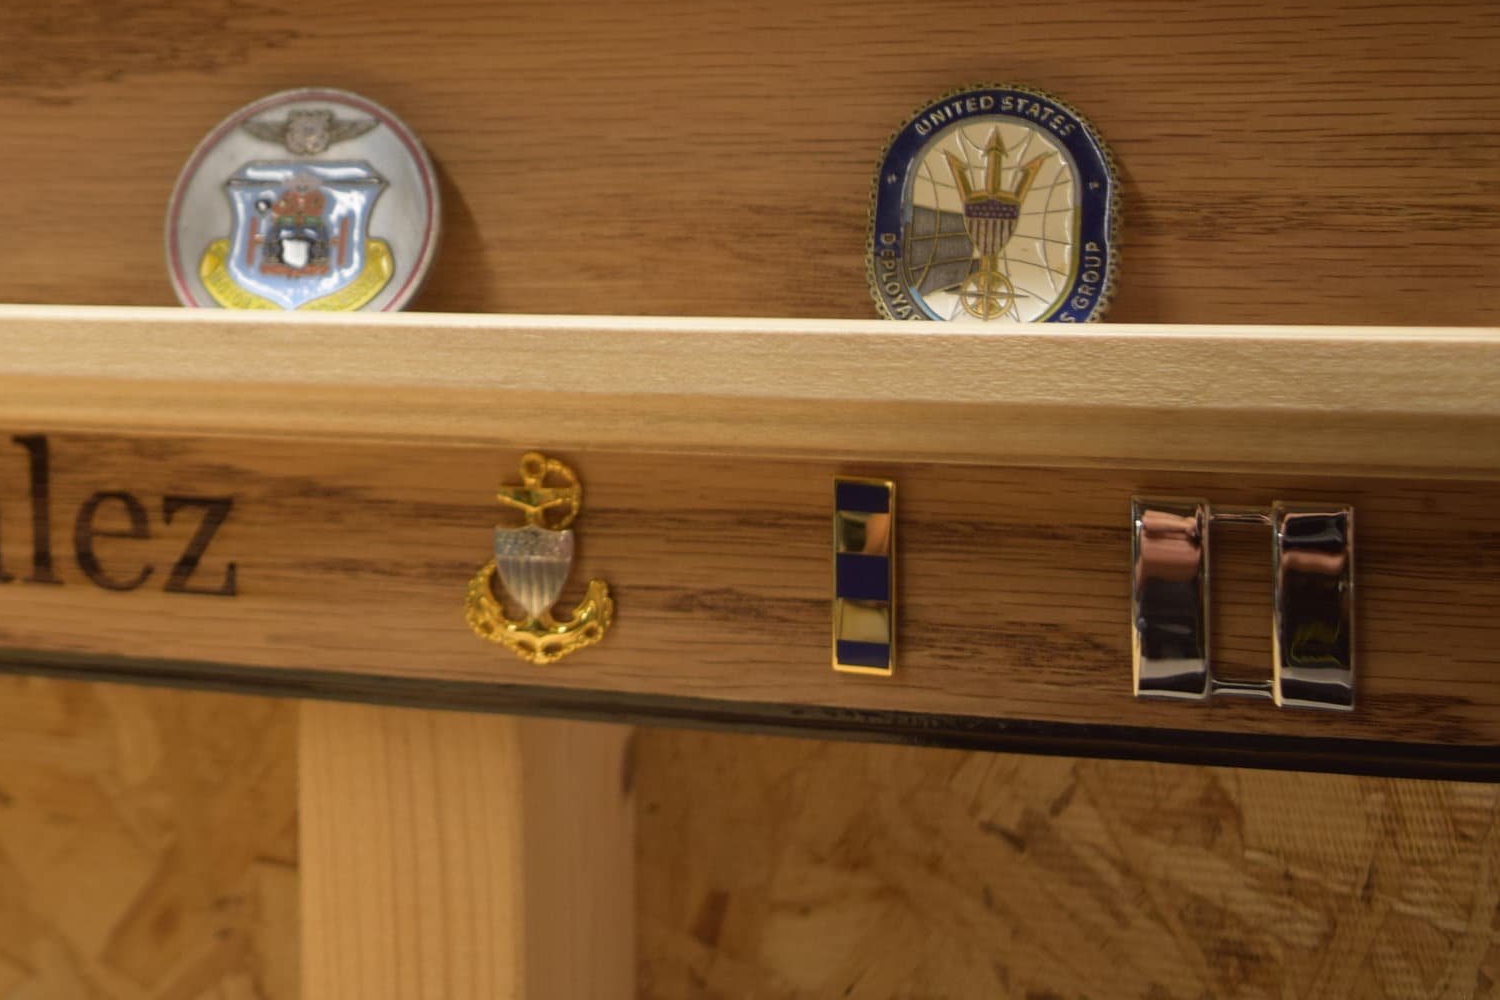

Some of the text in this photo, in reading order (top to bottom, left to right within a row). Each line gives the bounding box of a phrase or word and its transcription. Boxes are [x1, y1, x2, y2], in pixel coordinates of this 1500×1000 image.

[915, 95, 1077, 137] UNITED STATES
[1070, 241, 1102, 310] GROUP
